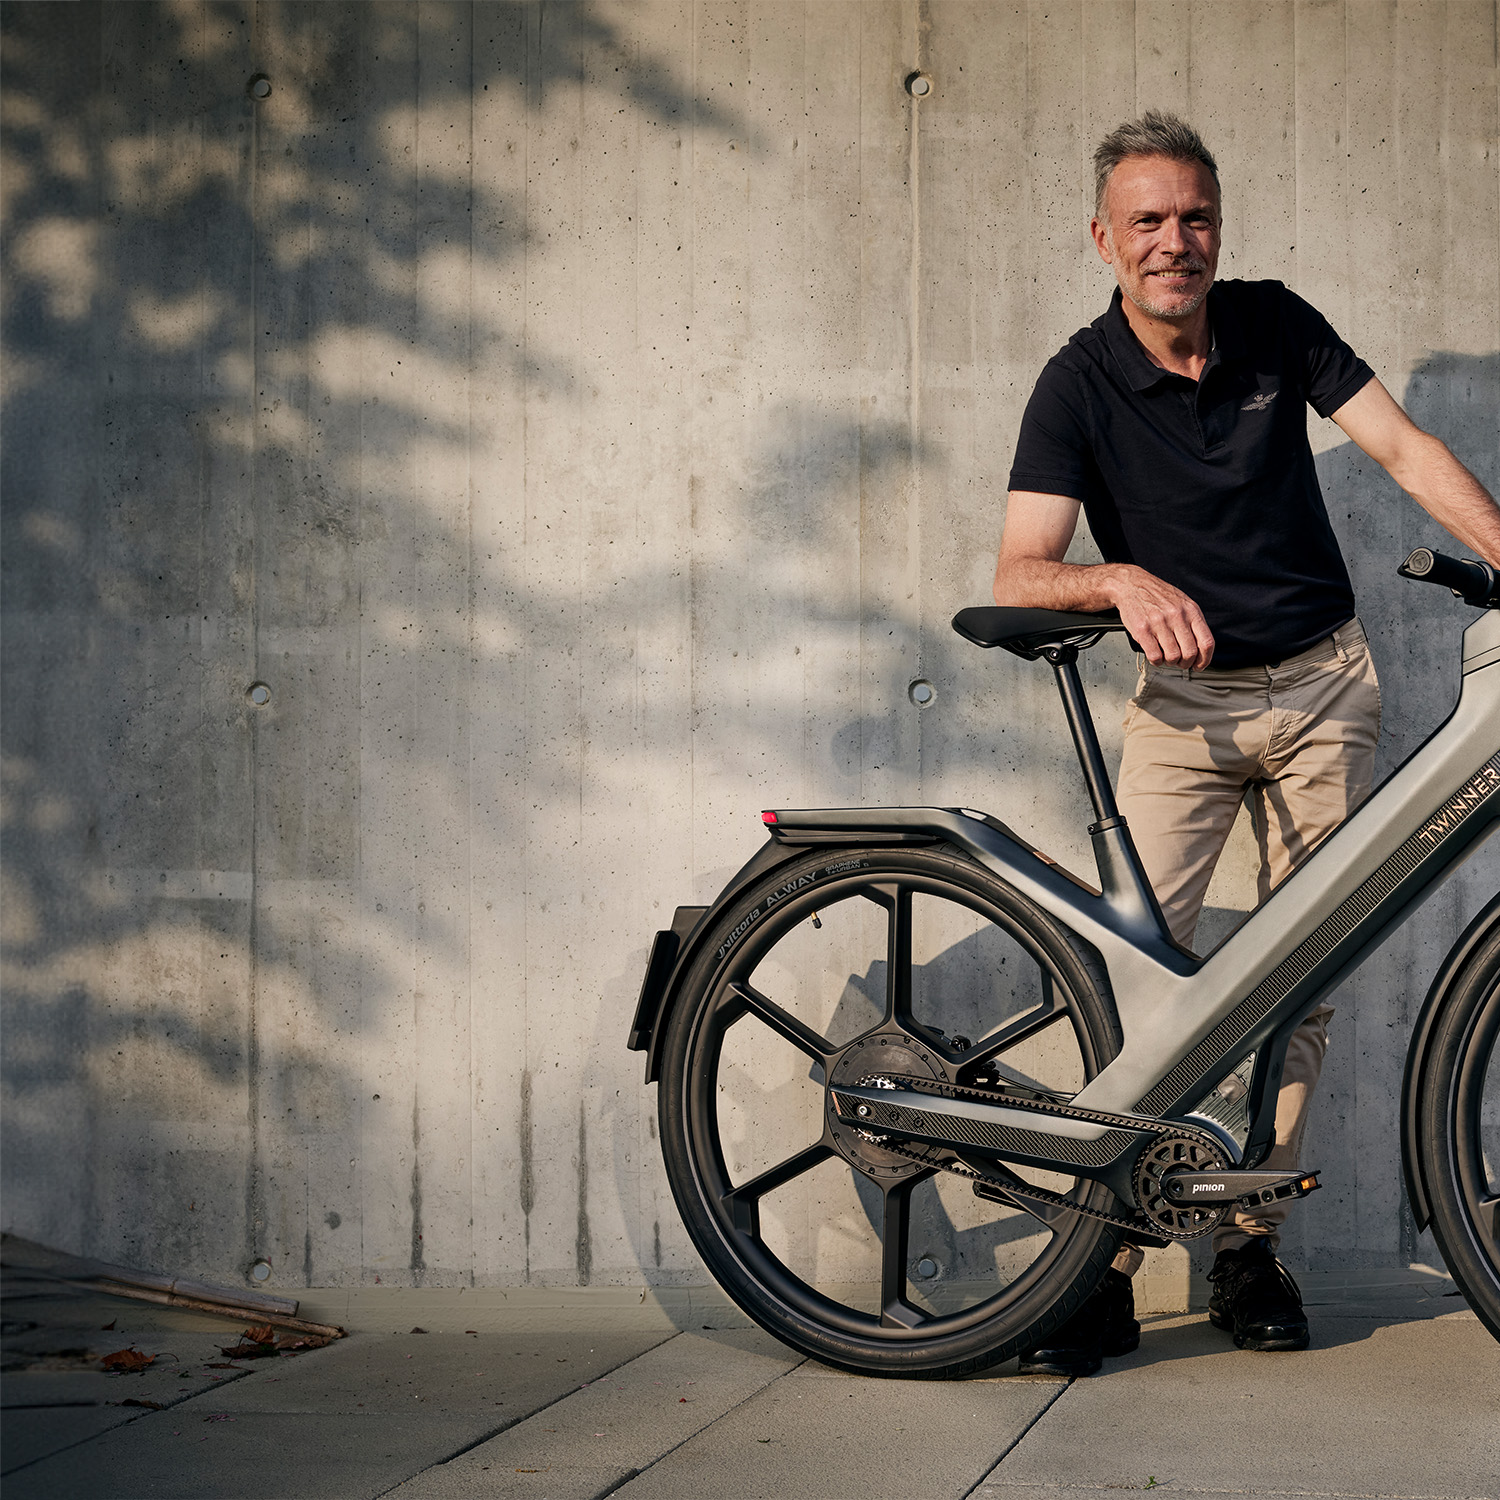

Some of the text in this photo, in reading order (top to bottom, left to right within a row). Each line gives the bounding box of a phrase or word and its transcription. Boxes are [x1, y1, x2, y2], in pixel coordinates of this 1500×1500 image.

[1419, 768, 1500, 842] TWINNER
[766, 872, 817, 908] ALWAY
[1192, 1184, 1225, 1194] pinion
